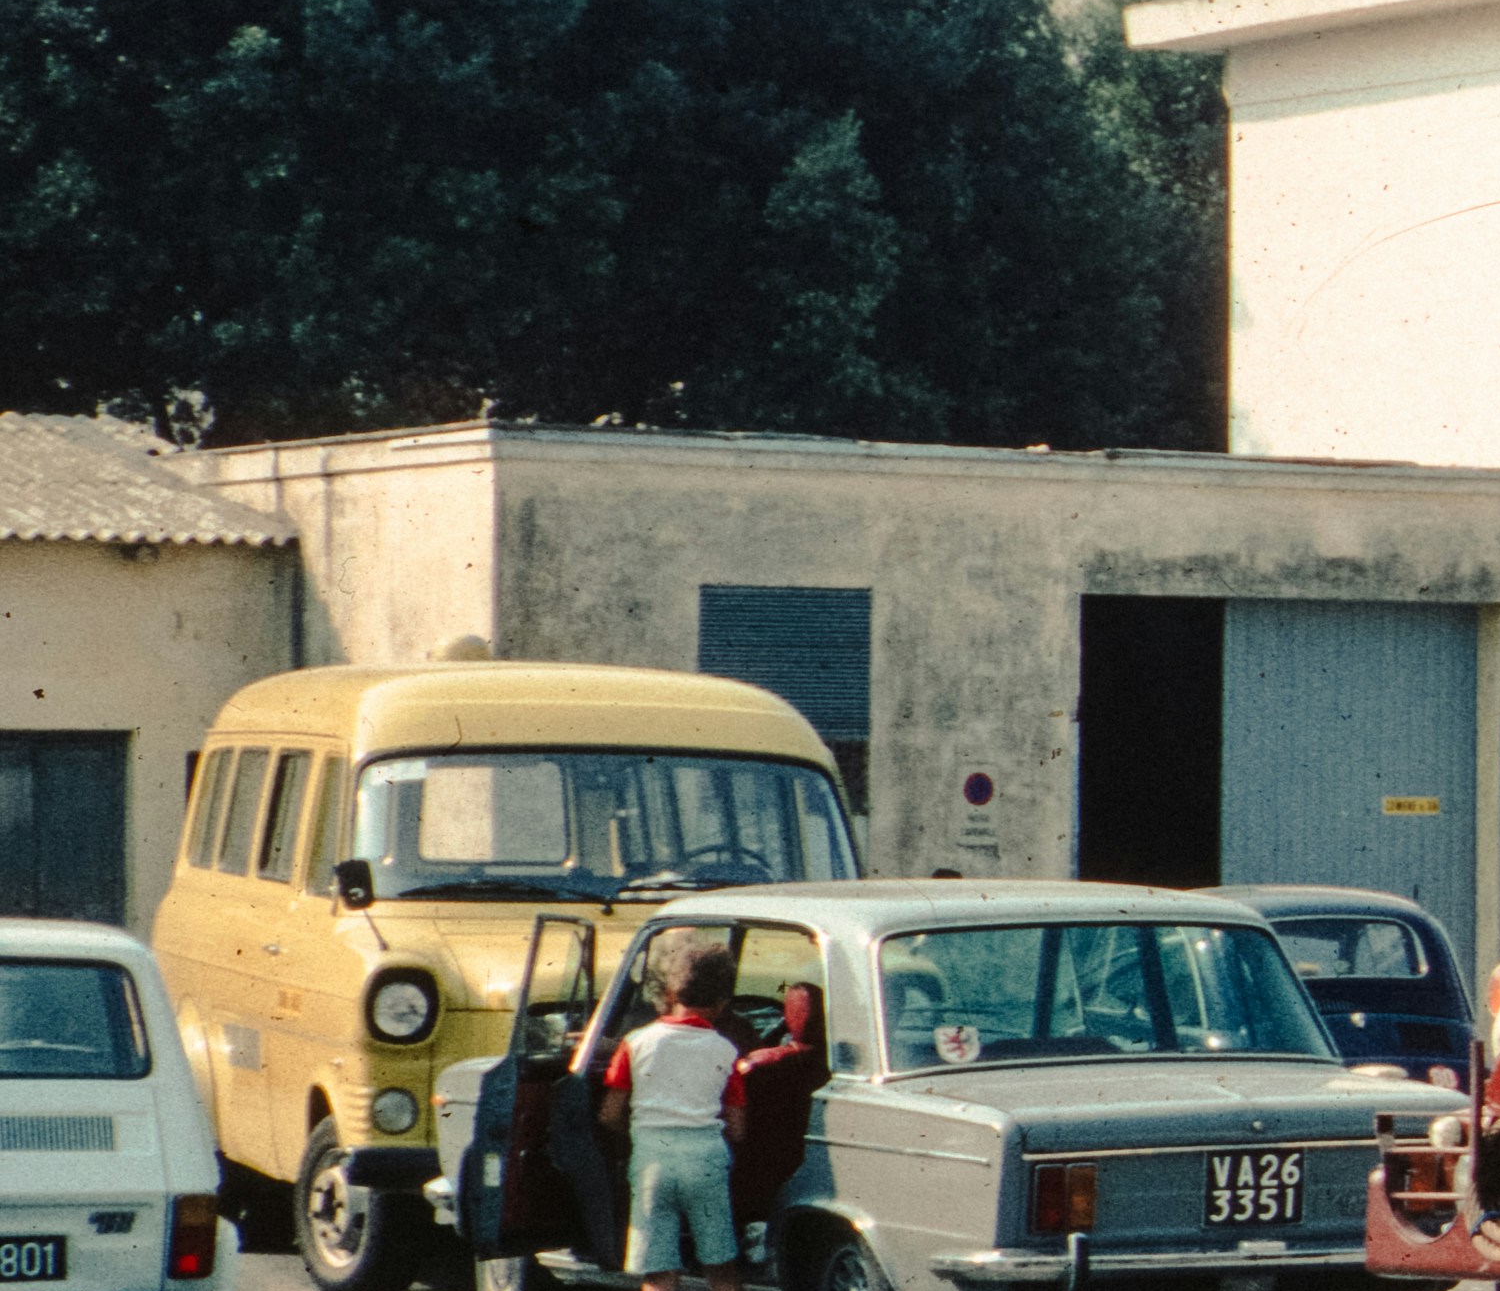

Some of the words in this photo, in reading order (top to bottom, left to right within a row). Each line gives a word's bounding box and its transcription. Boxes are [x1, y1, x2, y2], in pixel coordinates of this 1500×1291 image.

[1212, 1153, 1301, 1188] VA26
[1209, 1187, 1294, 1222] 3351
[0, 1241, 54, 1277] 801
